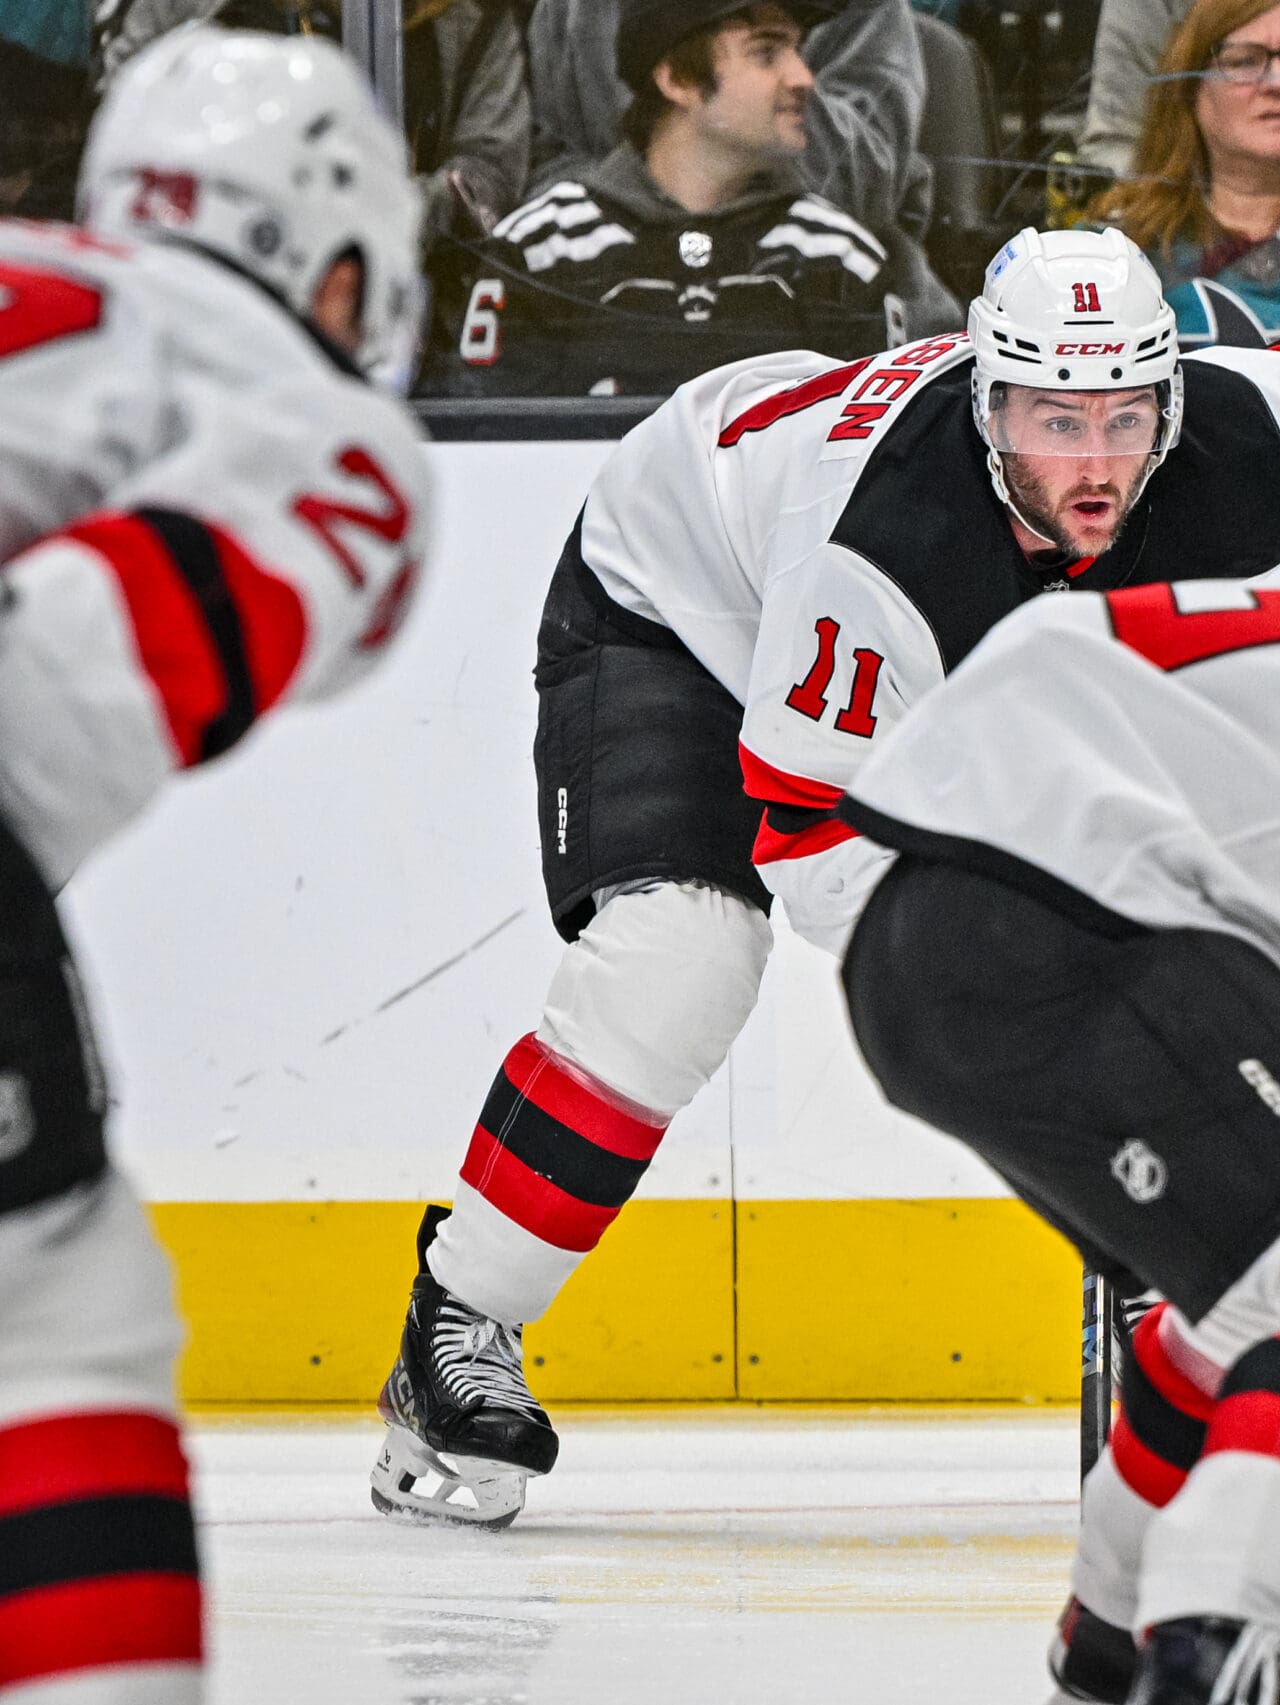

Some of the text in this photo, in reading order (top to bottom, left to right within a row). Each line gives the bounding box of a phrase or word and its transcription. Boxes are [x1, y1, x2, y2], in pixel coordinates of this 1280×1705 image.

[1071, 282, 1102, 312] 11
[1055, 342, 1126, 356] CCM
[785, 616, 884, 738] 11
[558, 787, 568, 854] CCM
